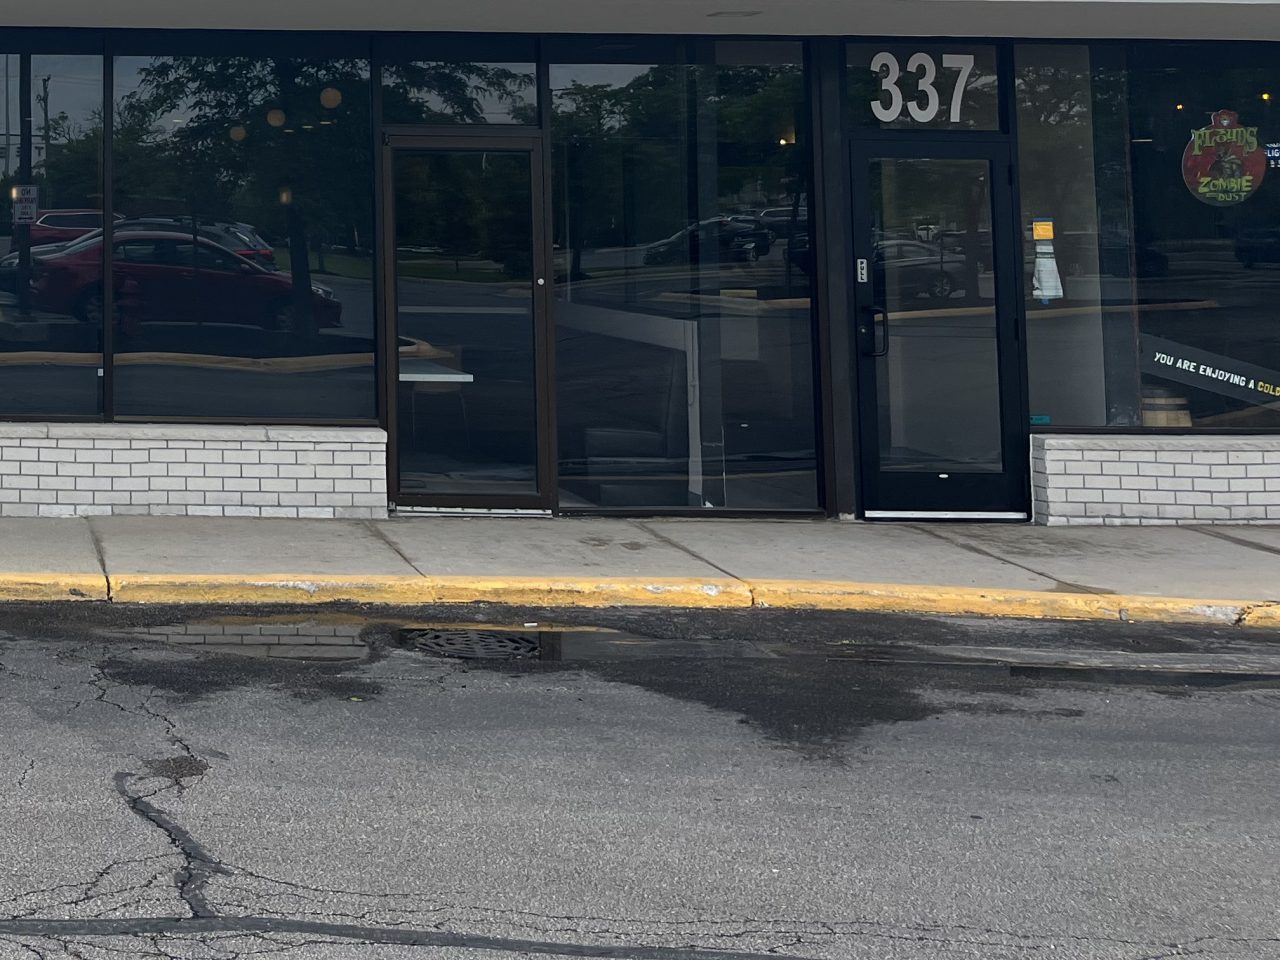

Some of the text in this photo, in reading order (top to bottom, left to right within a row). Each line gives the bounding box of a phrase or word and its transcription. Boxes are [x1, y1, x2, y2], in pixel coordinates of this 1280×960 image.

[870, 51, 974, 123] 337
[1198, 175, 1253, 193] ZOMBIE
[1218, 192, 1247, 201] DUST
[1154, 352, 1280, 397] YOU ARE ENJOYING A COLD
